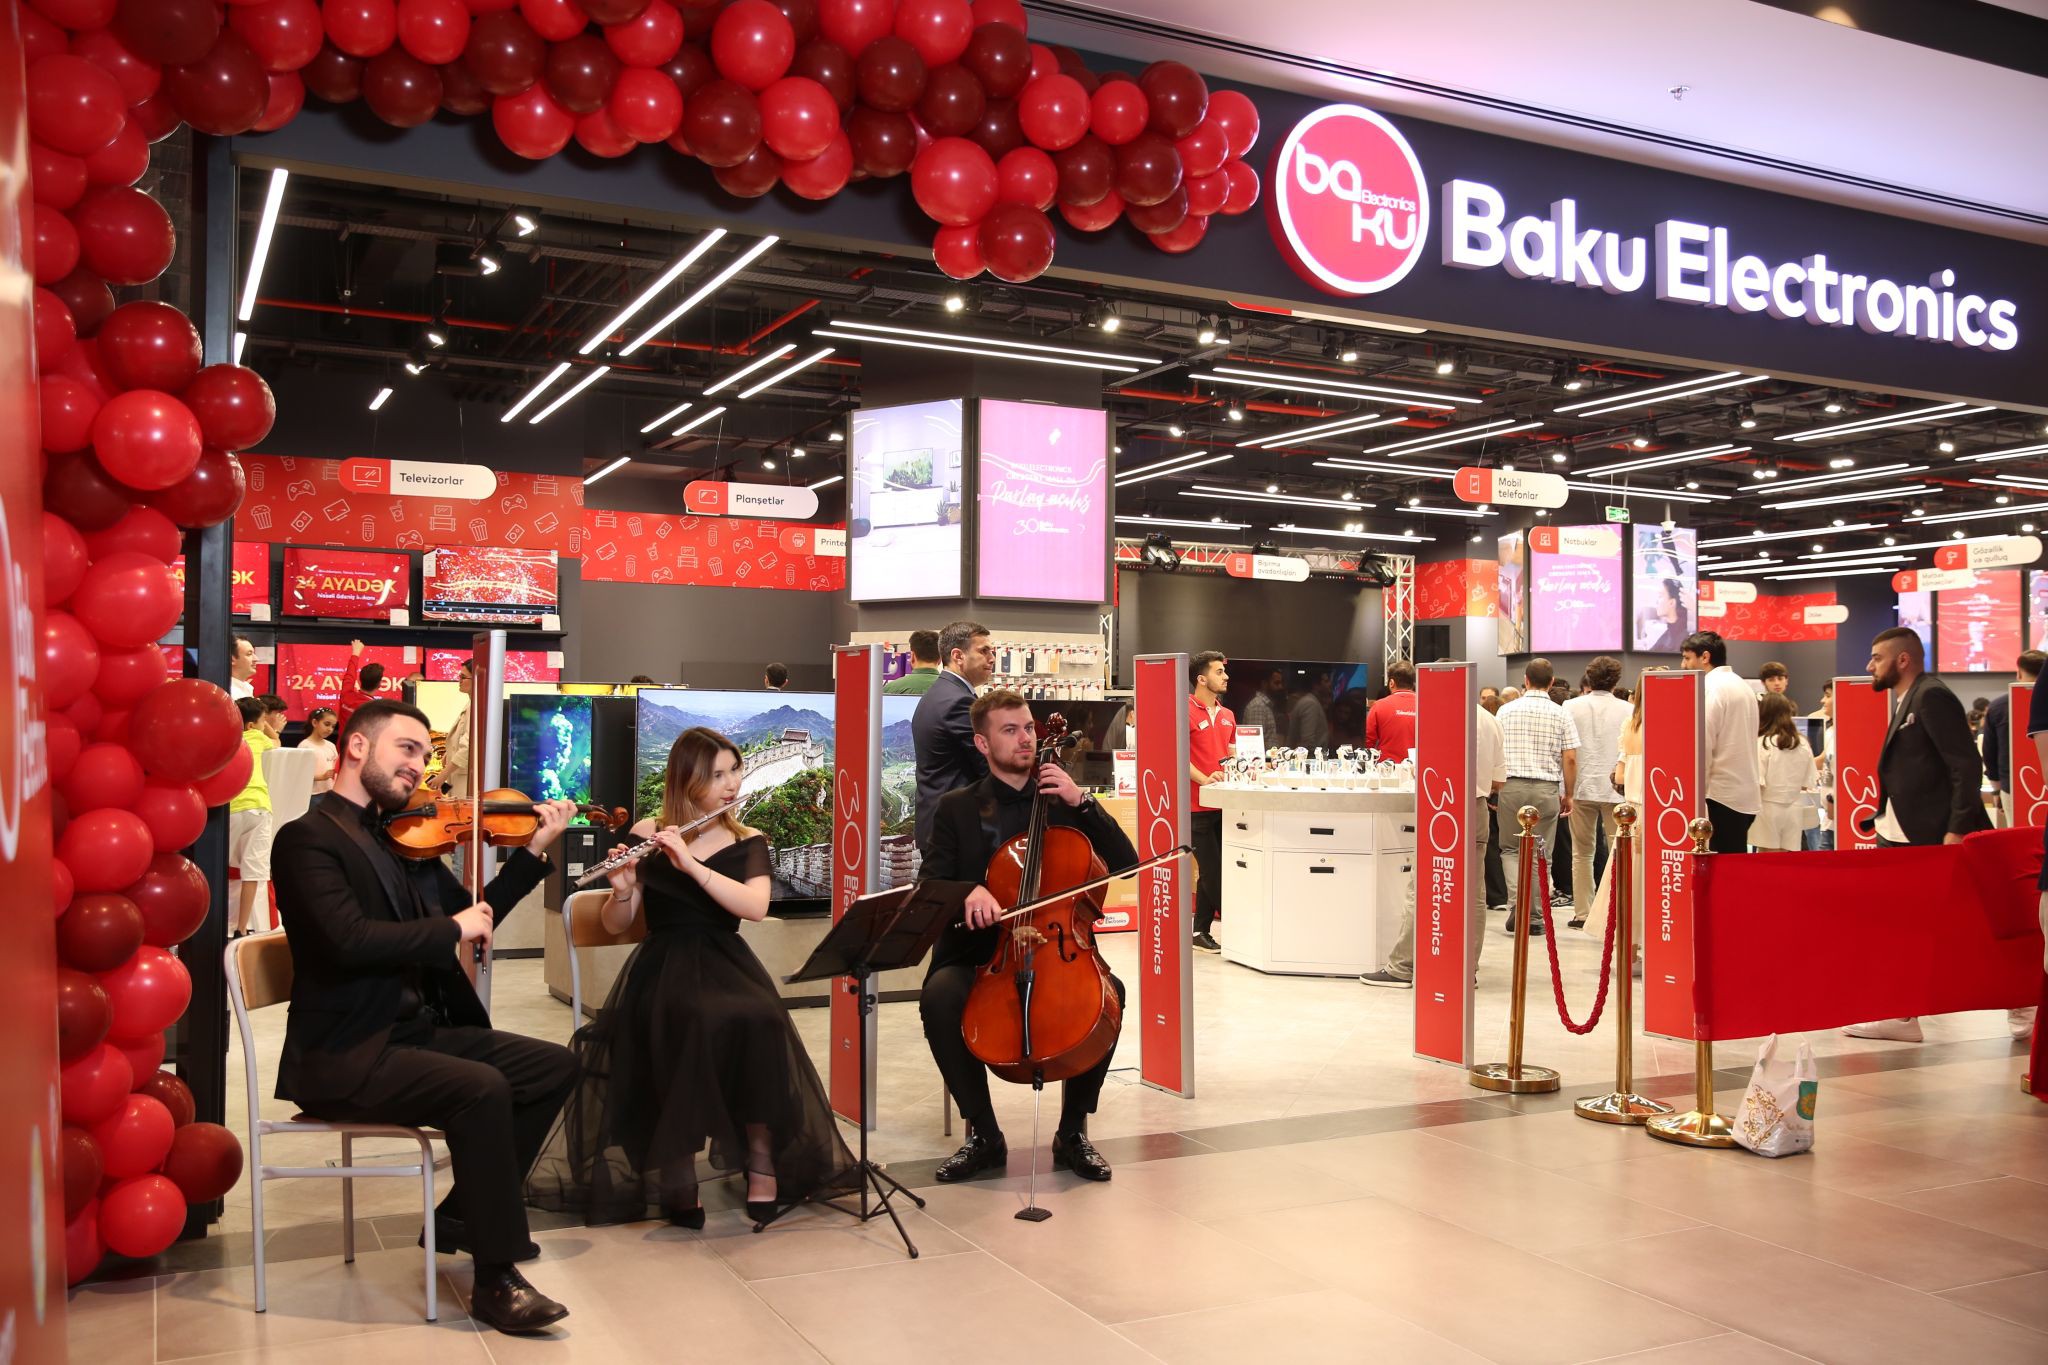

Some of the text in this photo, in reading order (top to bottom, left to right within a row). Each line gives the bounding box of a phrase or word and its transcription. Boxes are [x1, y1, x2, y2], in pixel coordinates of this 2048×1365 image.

[1443, 178, 2019, 352] Baku Electronics
[399, 472, 465, 486] Televizorlar
[735, 494, 785, 506] Planşetlər
[1498, 477, 1522, 488] Mobil
[1498, 489, 1539, 501] telefonlar
[1563, 537, 1598, 547] Notbuklar
[291, 674, 316, 691] 24
[1422, 766, 1459, 854] 30
[1650, 766, 1689, 847] 30
[1162, 867, 1171, 919] Baku
[1443, 857, 1455, 904] Baku
[1661, 849, 1674, 942] Electronics
[1673, 850, 1686, 894] Baku
[1152, 866, 1164, 976] Electronics
[1431, 855, 1444, 956] Electronics
